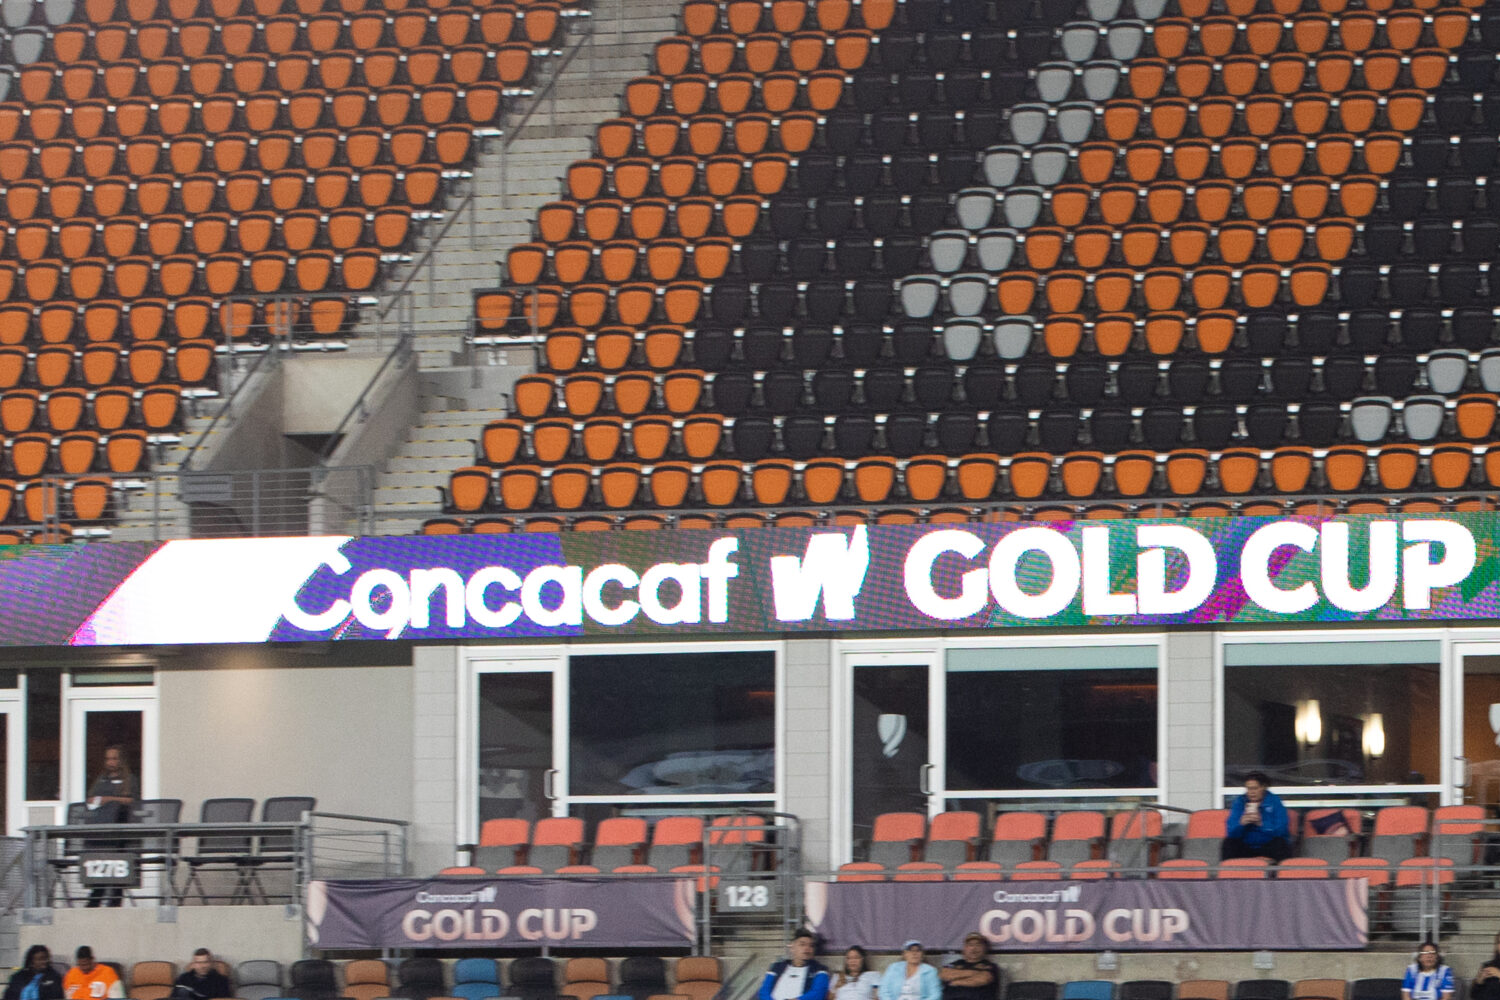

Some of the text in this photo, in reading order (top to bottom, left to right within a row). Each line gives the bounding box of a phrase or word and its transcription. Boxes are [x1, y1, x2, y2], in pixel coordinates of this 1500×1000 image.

[272, 537, 739, 639] Concacaf
[903, 526, 1217, 620] GOLD
[1240, 520, 1476, 614] CUP
[724, 885, 769, 907] 128
[402, 908, 598, 941] GOLD CUP
[980, 908, 1190, 943] GOLD CUP
